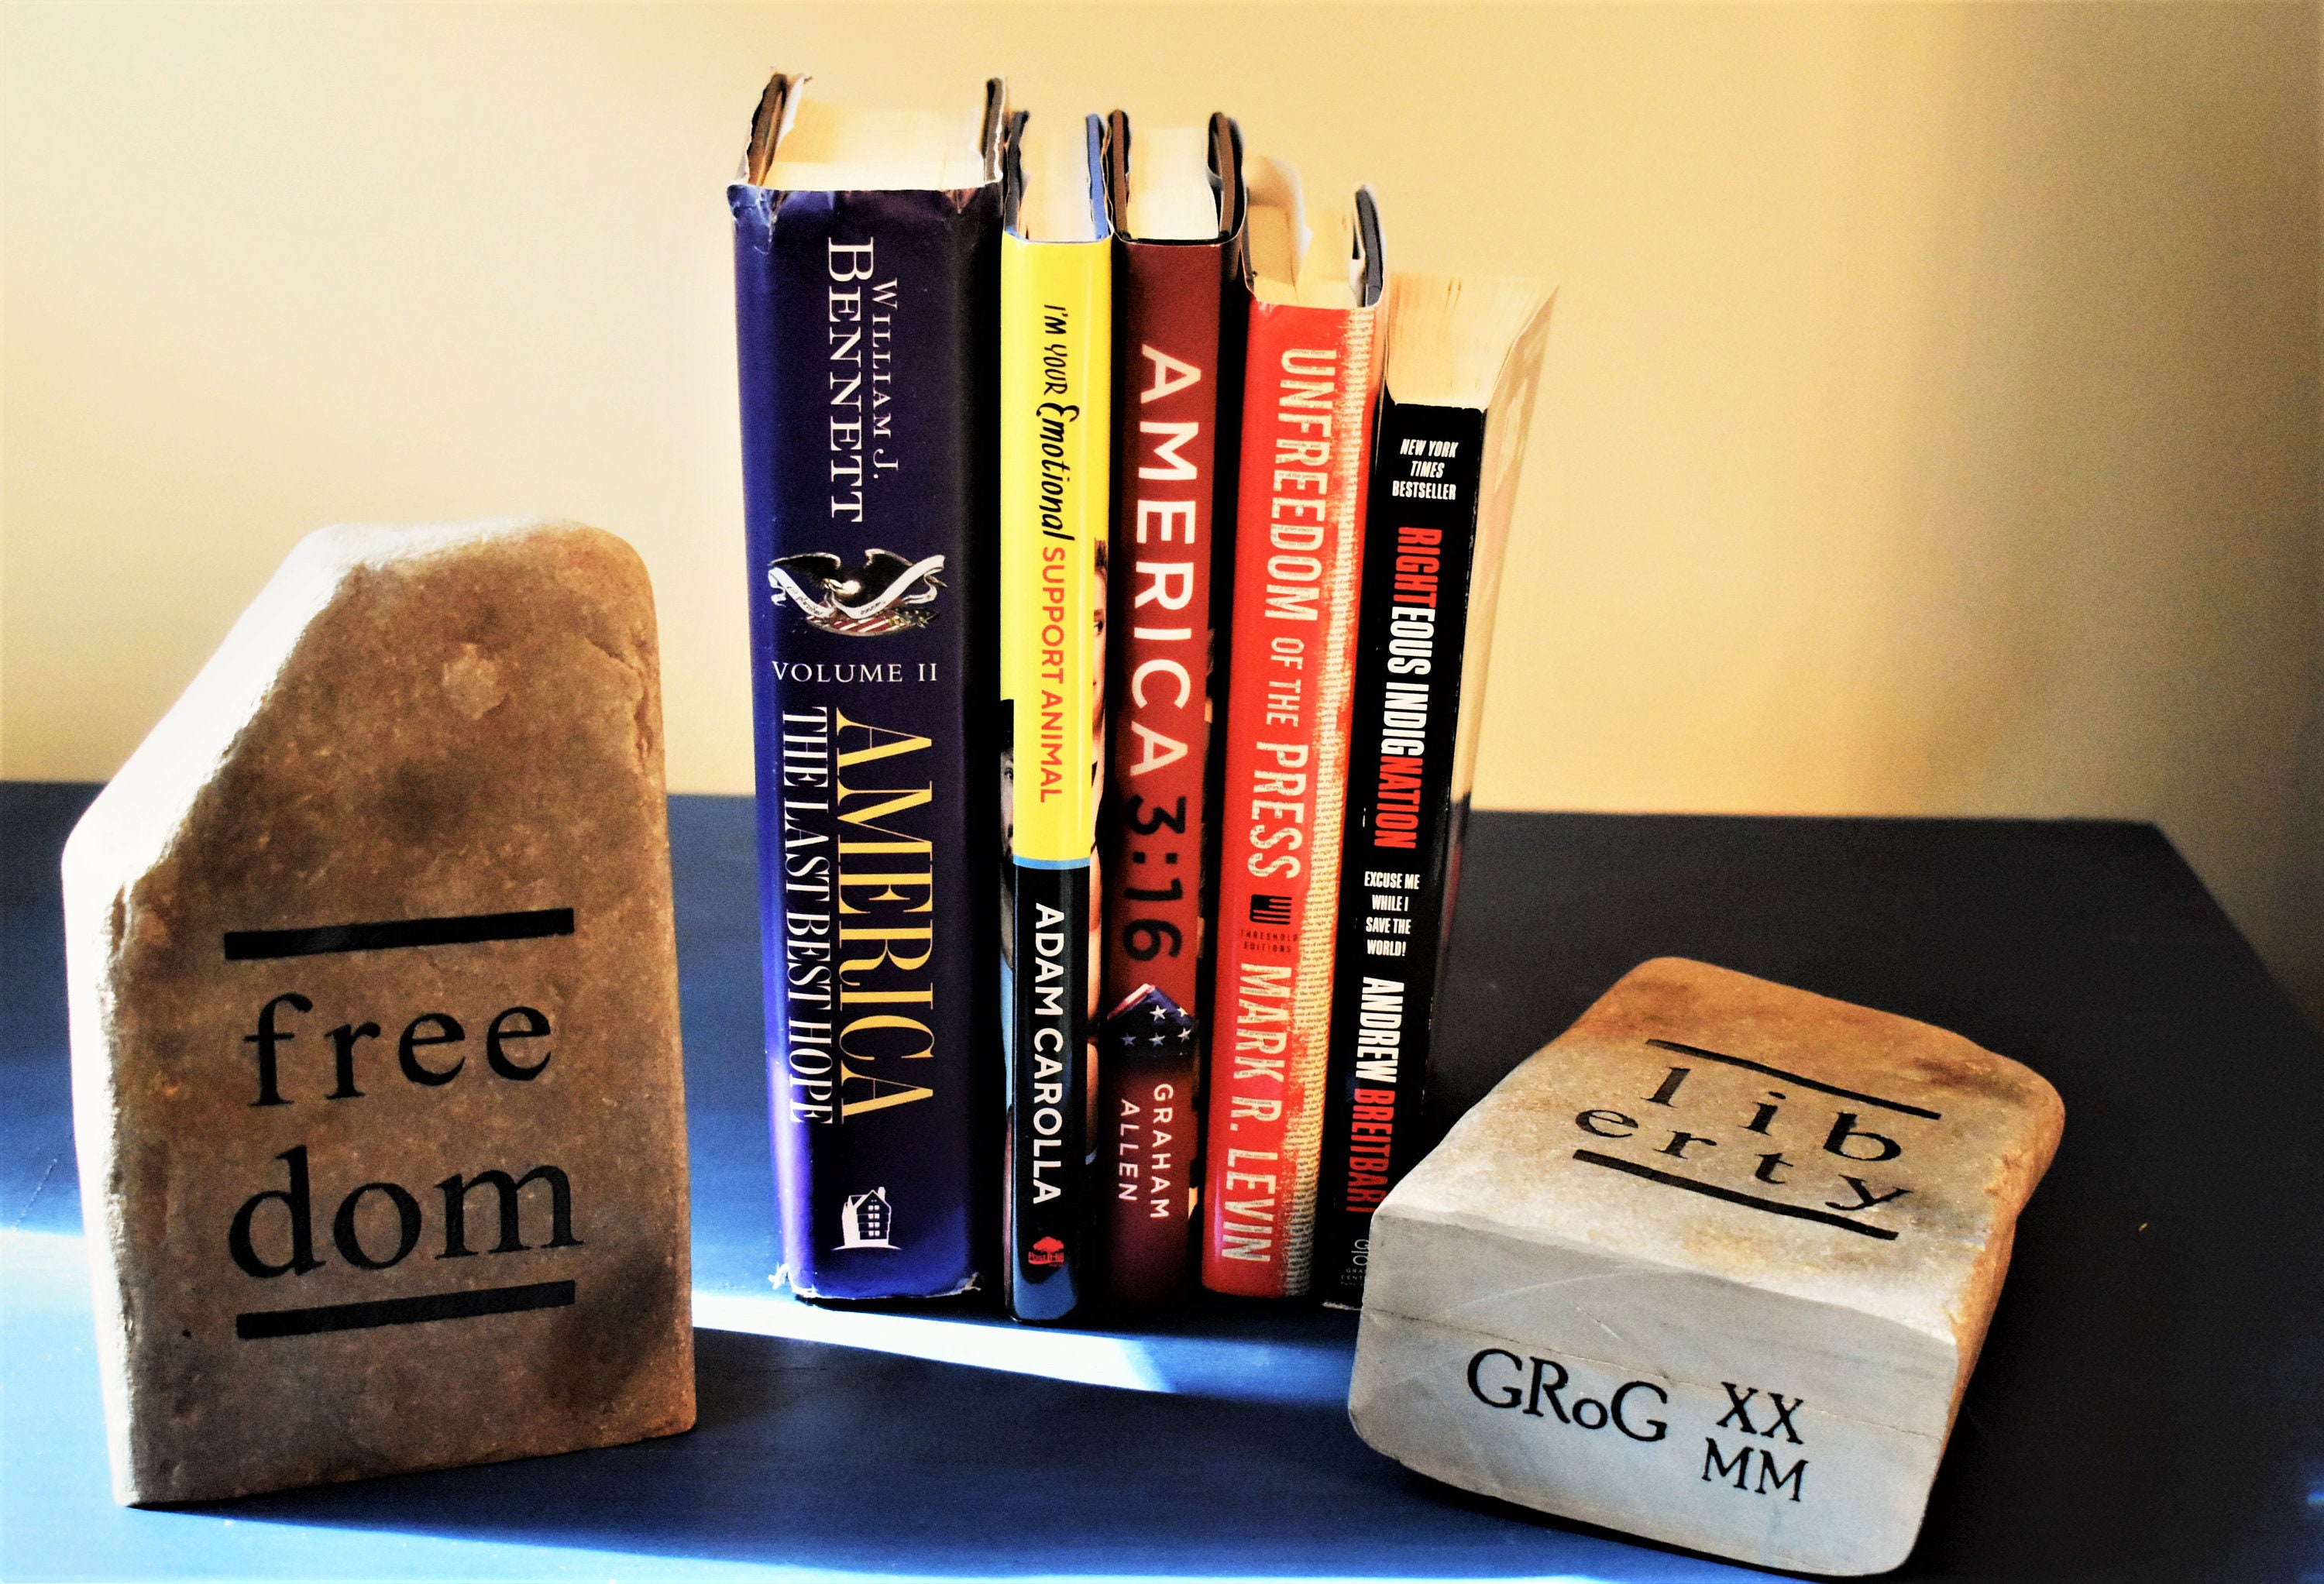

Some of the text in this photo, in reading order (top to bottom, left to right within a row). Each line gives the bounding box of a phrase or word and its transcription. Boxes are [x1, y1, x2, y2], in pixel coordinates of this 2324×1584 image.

[828, 236, 874, 523] BENNETT
[872, 278, 899, 479] WILLIAM J.
[1264, 348, 1337, 621] UNFREEDOM
[1392, 480, 1457, 500] BESTSELLER
[1400, 438, 1459, 458] NEW YORK
[1410, 460, 1446, 479] TIMES
[1036, 304, 1080, 803] I'M YOUR Emotional SUPPORT ANIMAL
[772, 661, 937, 683] VOLUME II
[1123, 344, 1202, 961] AMERICA 3:16
[1266, 678, 1302, 728] THE
[1270, 637, 1305, 671] OF
[1374, 527, 1442, 848] RIGHTEOUS INDIGNATION
[1247, 741, 1309, 879] PRESS
[782, 706, 834, 1125] THE LAST BEST HOPE
[836, 706, 934, 1124] AMERICA
[1364, 871, 1421, 890] EXCUSE ME
[1365, 916, 1411, 935] SAVE THE
[1372, 894, 1409, 912] WHILE I
[1367, 939, 1407, 957] WORLD!
[243, 992, 552, 1108] free
[1033, 902, 1065, 1204] ADAM CAROLLA
[1233, 963, 1292, 1083] MARK
[1355, 976, 1404, 1083] ANDREW
[1119, 1098, 1140, 1201] ALLEN
[1150, 1083, 1174, 1218] GRAHAM
[1230, 1094, 1282, 1132] R.
[1575, 1109, 1913, 1211] erty
[1640, 1067, 1902, 1162] lib
[229, 1144, 585, 1279] dom
[1221, 1147, 1276, 1263] LEVIN
[1466, 1348, 1804, 1445] GRoG XX
[1700, 1437, 1810, 1503] MM
